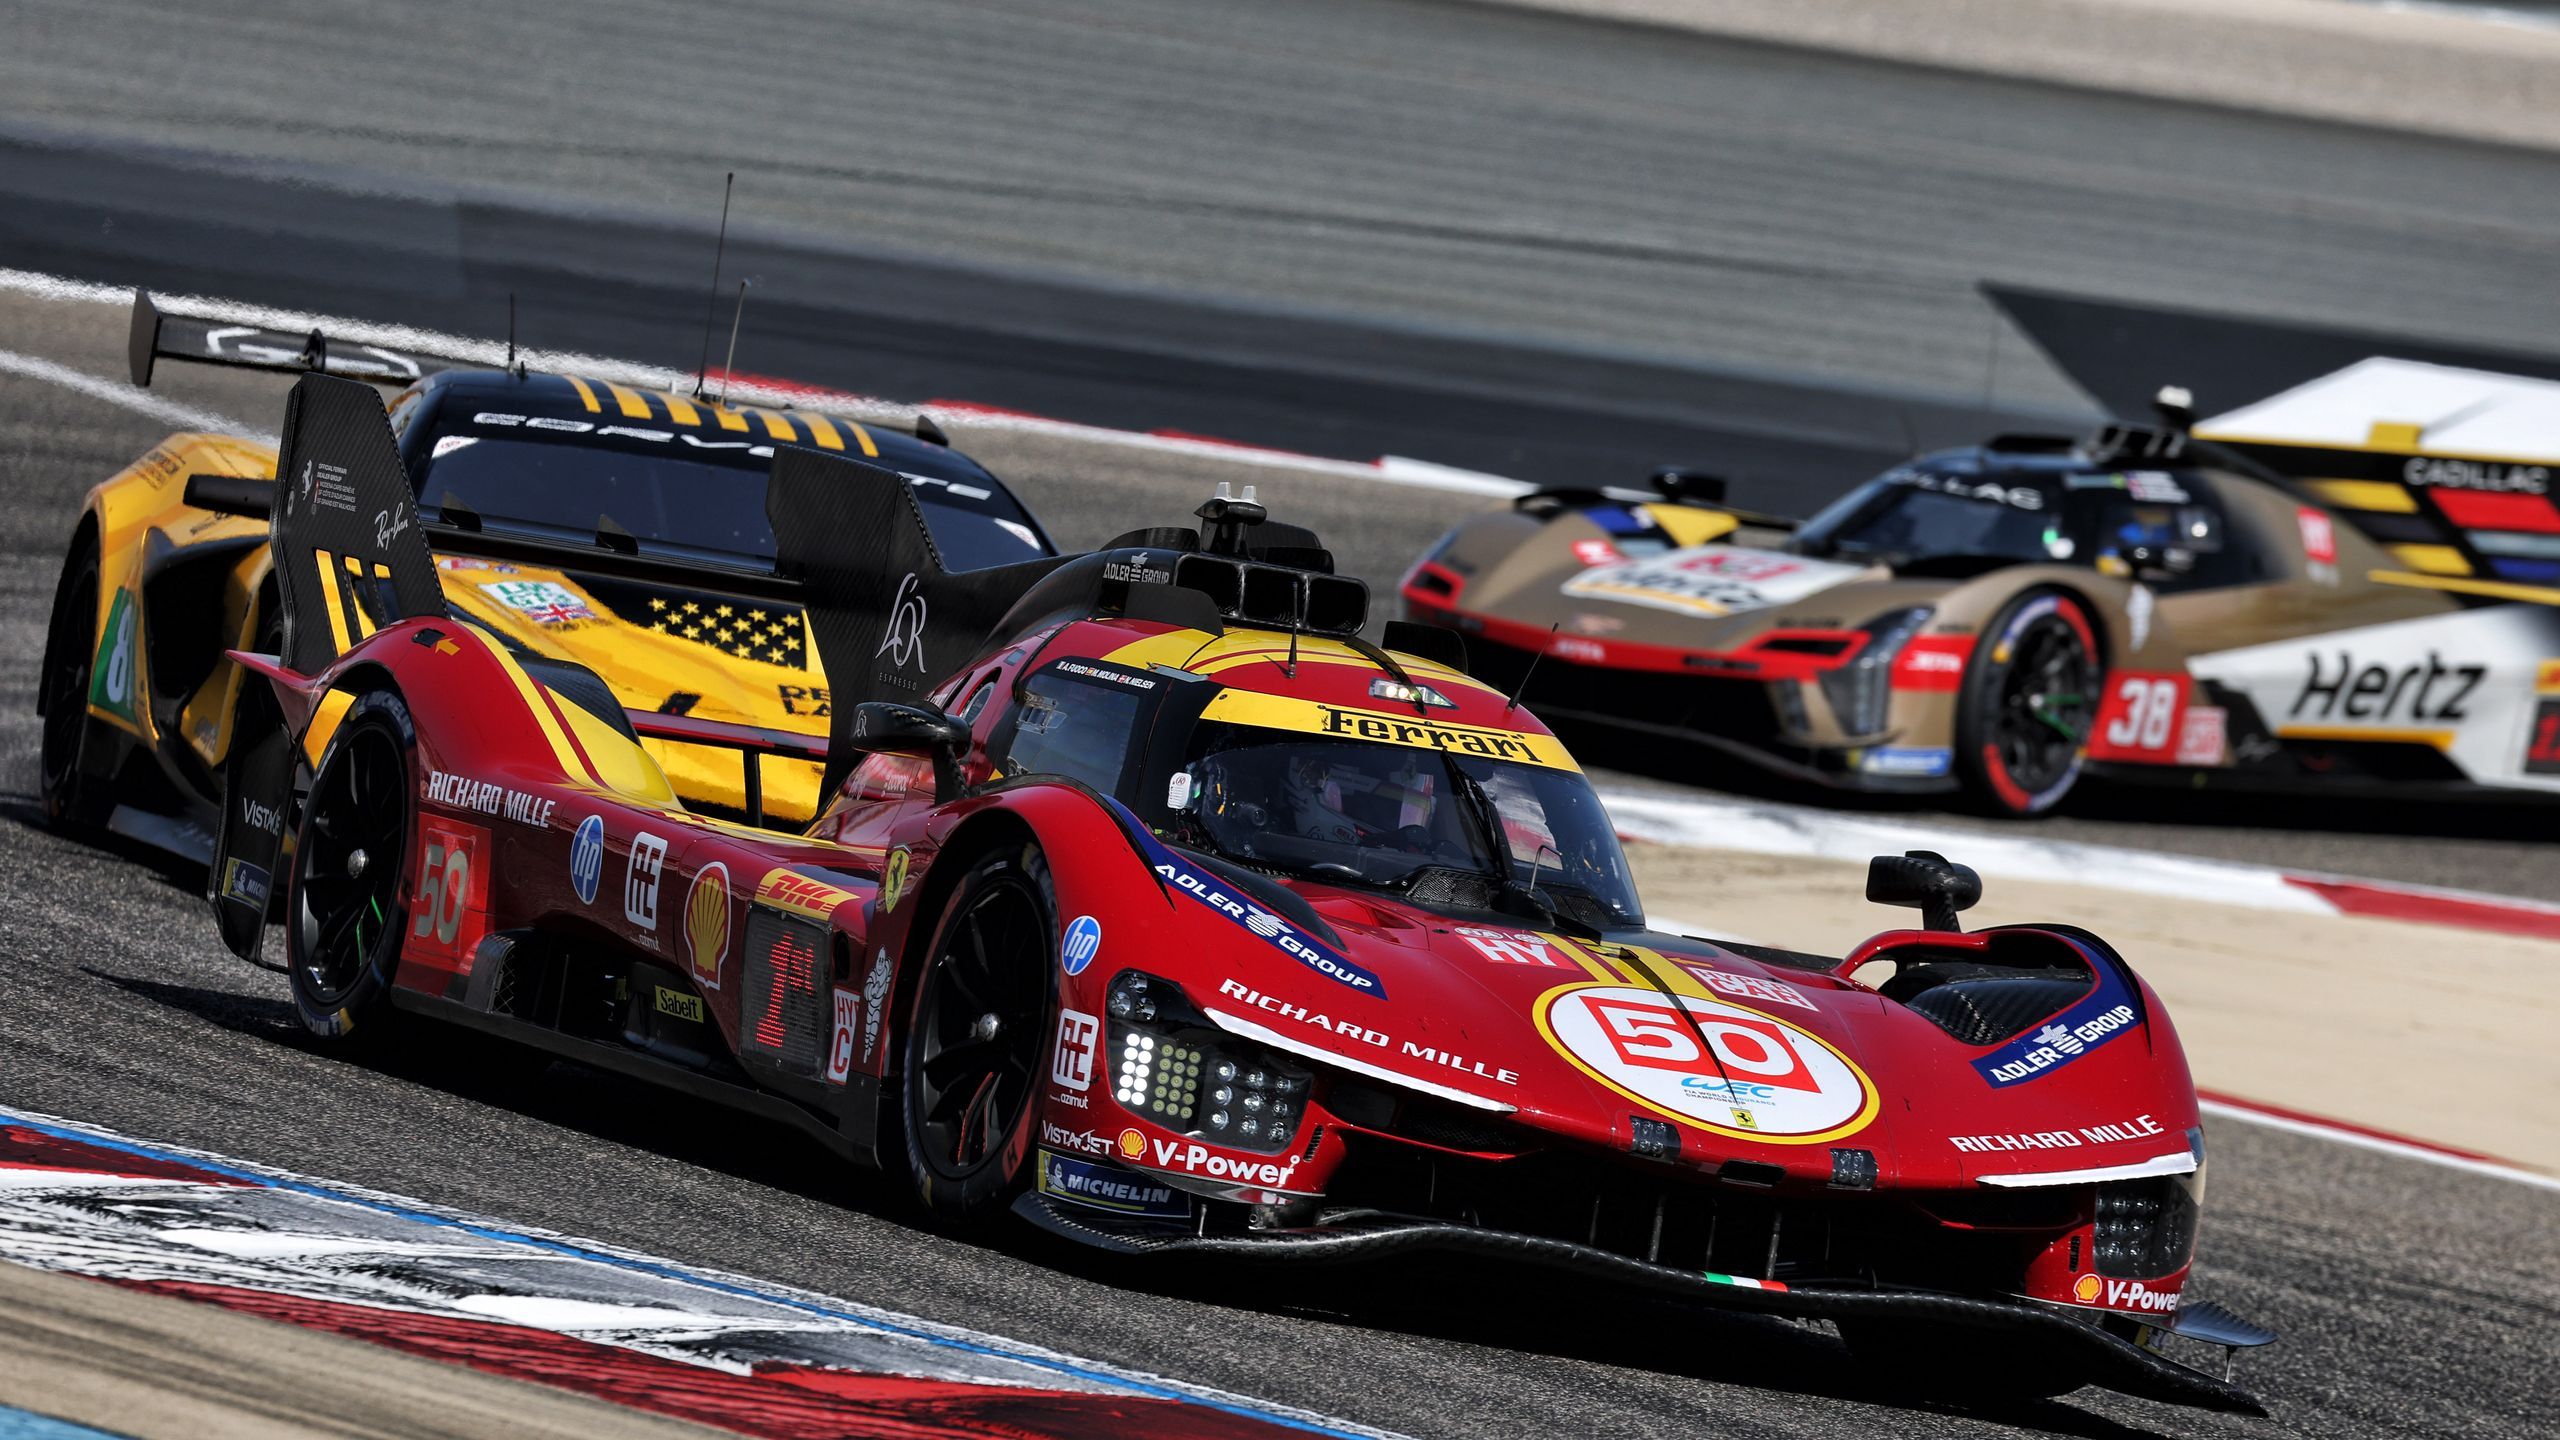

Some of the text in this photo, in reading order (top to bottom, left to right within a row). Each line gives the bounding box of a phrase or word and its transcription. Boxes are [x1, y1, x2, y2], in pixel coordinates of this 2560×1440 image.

[2401, 455, 2551, 495] CADILLAC
[1103, 562, 1170, 585] ADLER GROUP
[878, 671, 918, 692] ESPRESSO
[2287, 649, 2489, 723] Hertz
[1322, 704, 1543, 764] Ferrari
[2106, 677, 2179, 750] 38
[428, 770, 556, 829] RICHARD MILLE
[571, 816, 602, 903] hp
[414, 842, 469, 945] 50
[766, 874, 838, 911] DHL
[1066, 916, 1097, 975] hp
[1154, 864, 1374, 989] ADLER GROUP
[1463, 937, 1558, 967] HY
[660, 989, 698, 1020] Sabelt
[1218, 977, 1520, 1086] RICHARD MILLE
[1598, 1004, 1795, 1078] 50
[1990, 1005, 2135, 1083] ADLER GROUP
[1060, 1092, 1089, 1110] azimut
[1681, 1077, 1775, 1099] WEC
[1948, 1114, 2166, 1153] RICHARD MILLE
[1067, 1172, 1172, 1204] MICHELIN
[1153, 1138, 1296, 1187] V-Power
